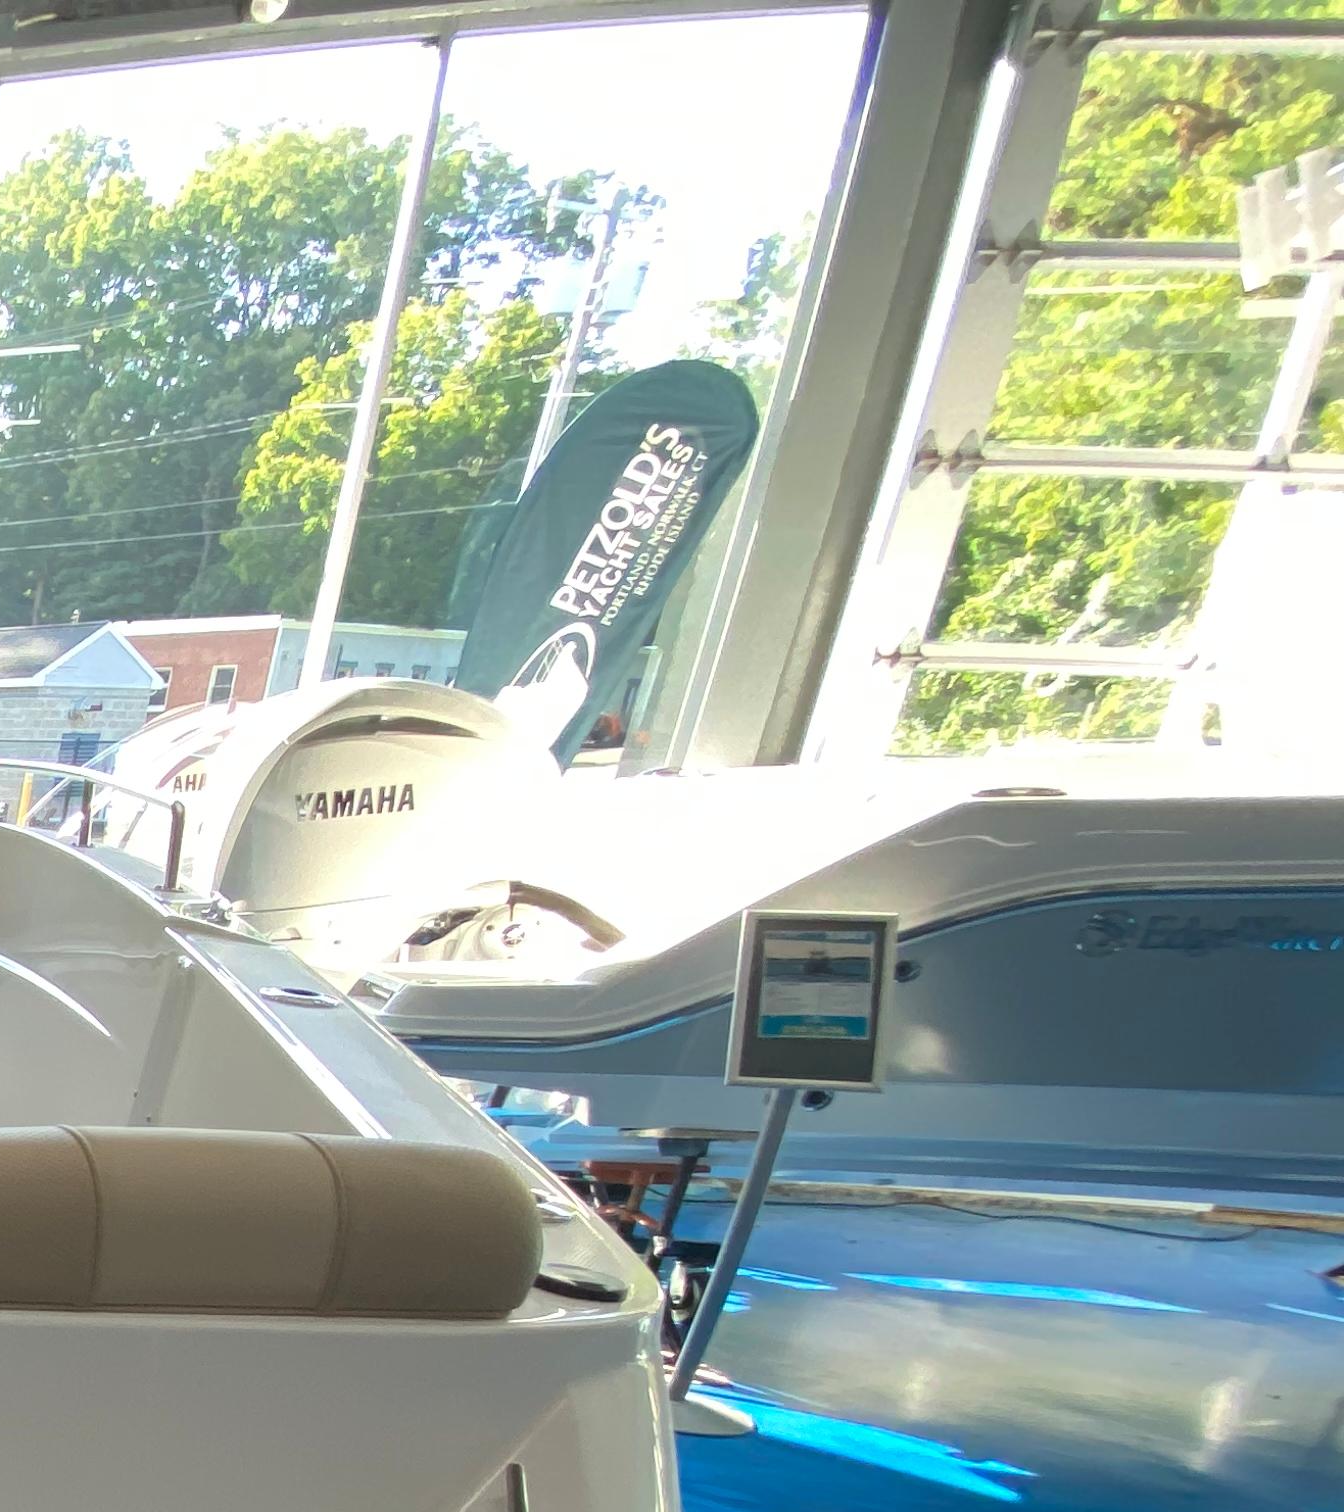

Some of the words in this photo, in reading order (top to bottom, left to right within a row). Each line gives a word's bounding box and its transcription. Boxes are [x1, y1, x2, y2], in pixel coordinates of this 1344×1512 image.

[549, 423, 681, 616] PETZOLD'S
[578, 530, 642, 617] YACHT
[632, 443, 695, 530] SALES
[664, 491, 702, 543] ISLAND
[600, 552, 651, 626] PORTLAND
[294, 783, 415, 822] YAMAHA
